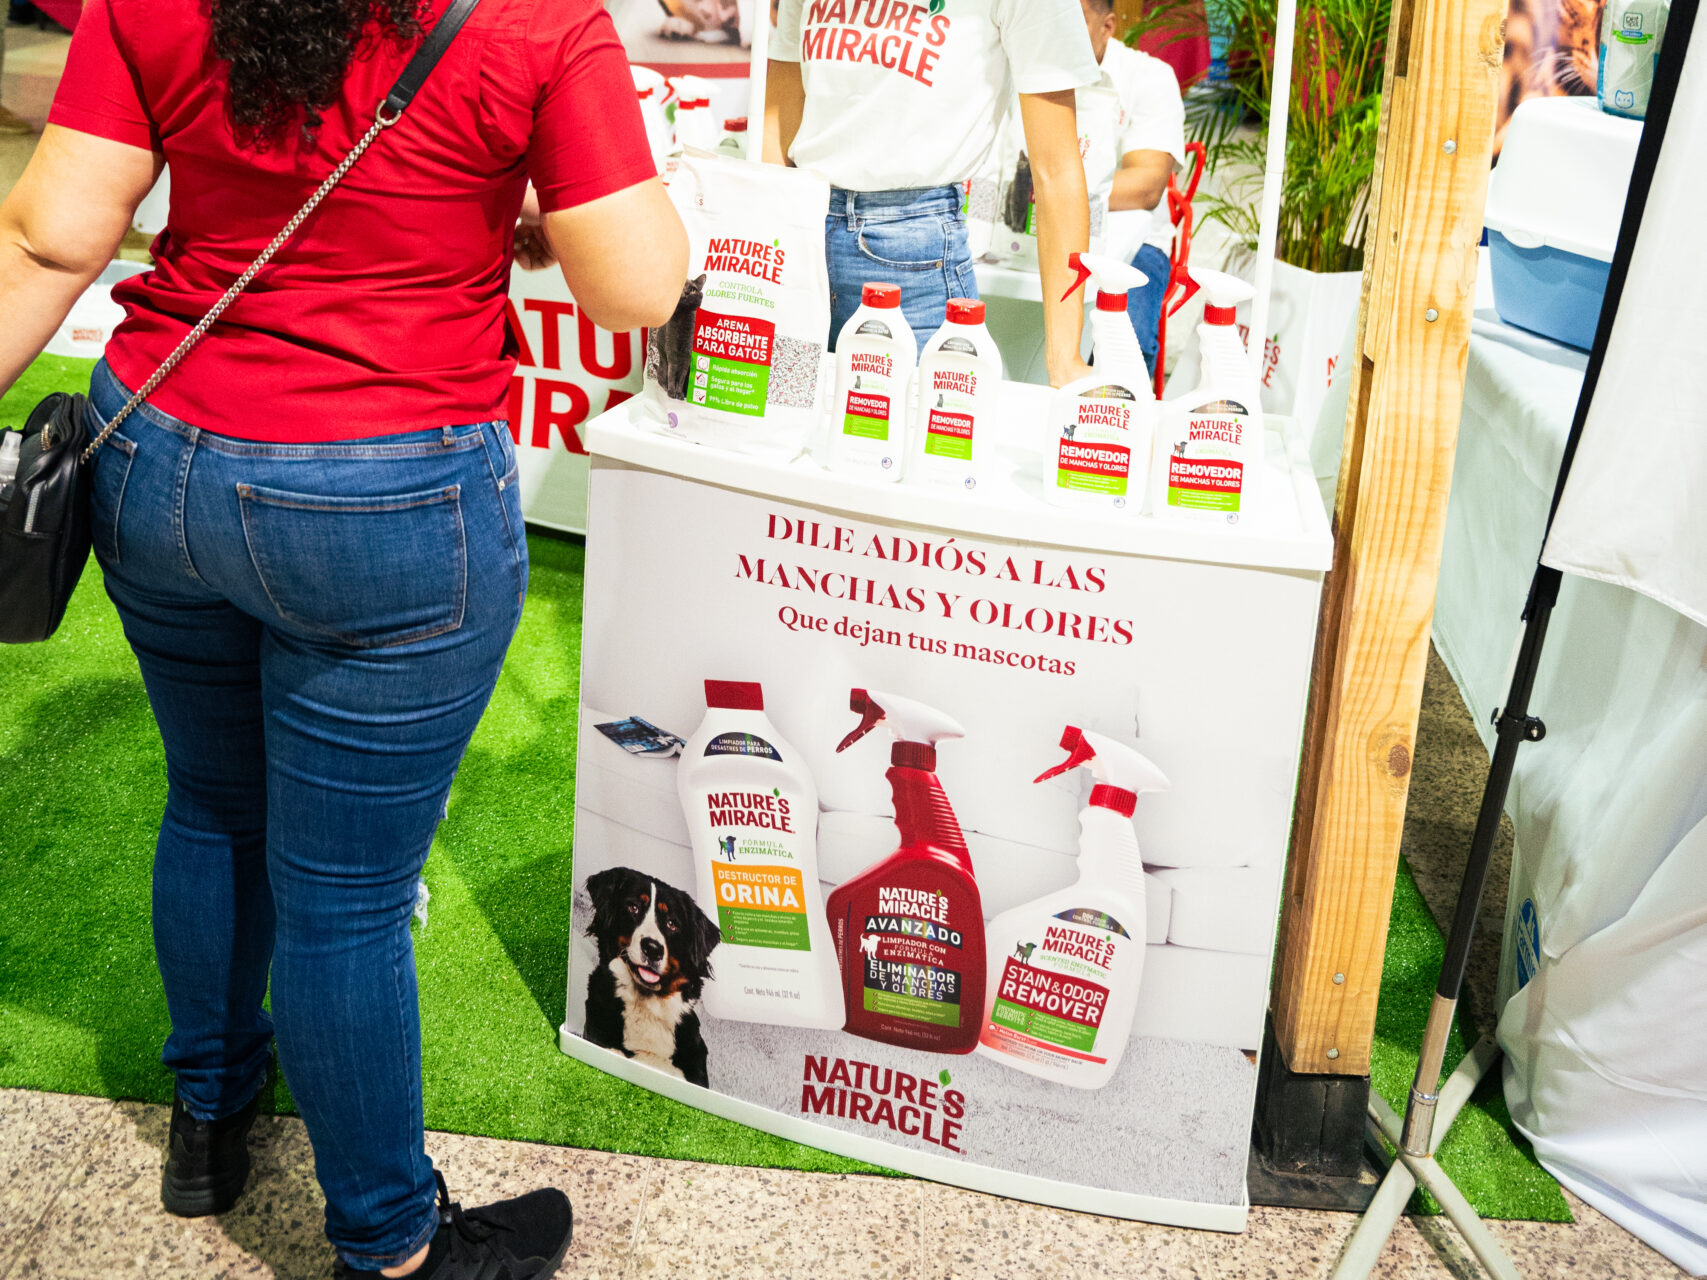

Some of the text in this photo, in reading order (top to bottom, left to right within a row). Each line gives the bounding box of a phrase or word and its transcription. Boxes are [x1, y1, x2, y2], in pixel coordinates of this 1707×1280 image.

[802, 27, 940, 88] MIRACLE
[707, 238, 785, 266] NATURE'S
[703, 255, 783, 285] MIRACLE
[705, 288, 775, 309] OLORES FUERTES
[719, 280, 763, 296] CONTROLA
[716, 318, 750, 332] ARENA
[697, 325, 769, 349] ABSORBENTE
[696, 338, 767, 361] PARA GATOS
[851, 352, 893, 367] NATURE'S
[851, 363, 892, 378] MIRACLE
[933, 370, 977, 386] NATURE'S
[933, 381, 976, 396] MIRACLE
[849, 396, 888, 409] REMOVEDOR
[1078, 403, 1130, 420] NATURE'S
[931, 414, 971, 429] REMOVEDOR
[1078, 414, 1129, 431] MIRACLE
[1190, 418, 1243, 434] NATURE'S
[1189, 429, 1241, 445] MIRACLE
[1060, 445, 1128, 464] REMOVEDOR
[1068, 459, 1099, 470] MANCHAS
[1099, 462, 1104, 470] Y
[1104, 463, 1127, 473] OLORES
[1170, 475, 1179, 483] DE
[1179, 476, 1210, 486] MANCHAS
[1215, 479, 1240, 488] OLORES
[1171, 463, 1241, 479] REMOVEDOR
[766, 513, 1106, 593] DILE ADIÓS A LAS
[735, 553, 1134, 646] MANCHAS Y OLORES
[778, 605, 1076, 676] Que dejan tus mascotas
[707, 787, 790, 815] NATURE'S
[709, 809, 793, 834] MIRACLE
[718, 870, 797, 885] DESTRUCTOR DE
[720, 883, 800, 908] ORINA
[880, 887, 949, 910] NATURE'S
[879, 900, 948, 924] MIRACLE
[866, 918, 961, 945] AVANZADO
[1046, 926, 1115, 956] NATURE'S
[882, 937, 946, 954] LIMPIADOR CON
[1042, 939, 1112, 970] MIRACLE
[870, 960, 955, 984] ELIMINADOR
[870, 970, 955, 993] DE MANCHAS
[880, 981, 943, 1001] Y OLORES
[1007, 965, 1105, 1007] STAIN & ODOR
[1002, 980, 1100, 1023] REMOVER
[803, 1055, 966, 1119] NATURE'S
